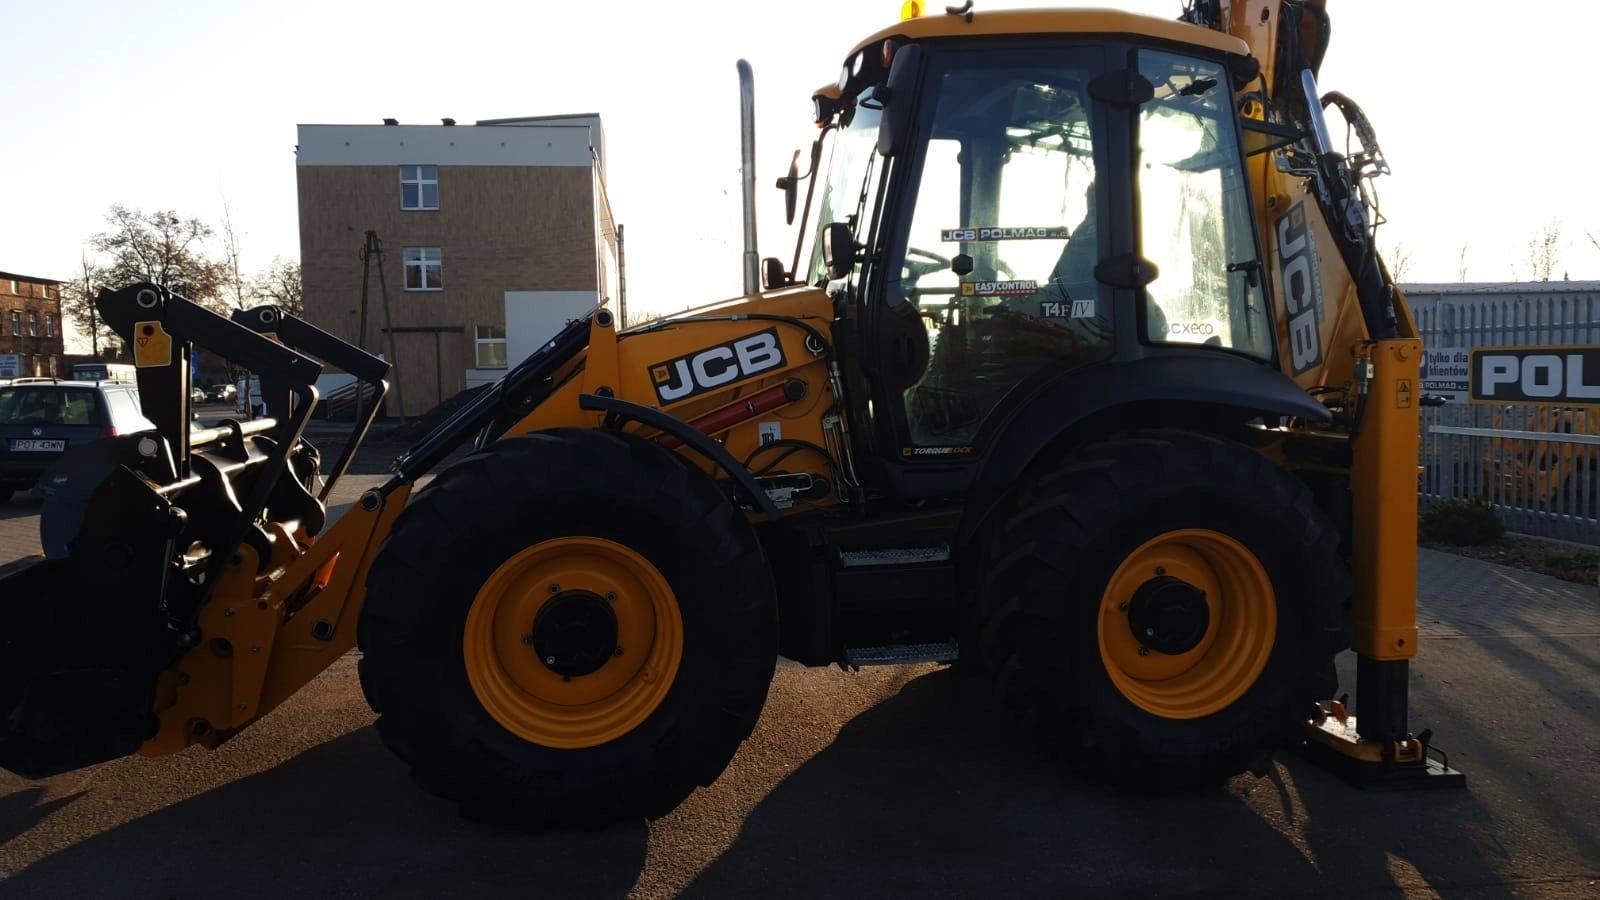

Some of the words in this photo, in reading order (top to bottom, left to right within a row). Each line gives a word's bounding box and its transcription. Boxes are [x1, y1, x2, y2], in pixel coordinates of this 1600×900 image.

[943, 230, 976, 241] JCB
[980, 227, 1047, 239] POLMAG
[975, 281, 1037, 291] EASYCONTROL
[1278, 216, 1319, 370] JCB
[1429, 351, 1450, 365] tylko
[1453, 351, 1469, 363] dla
[658, 333, 782, 400] JCB
[1429, 364, 1469, 377] klientów
[1481, 354, 1600, 399] POL
